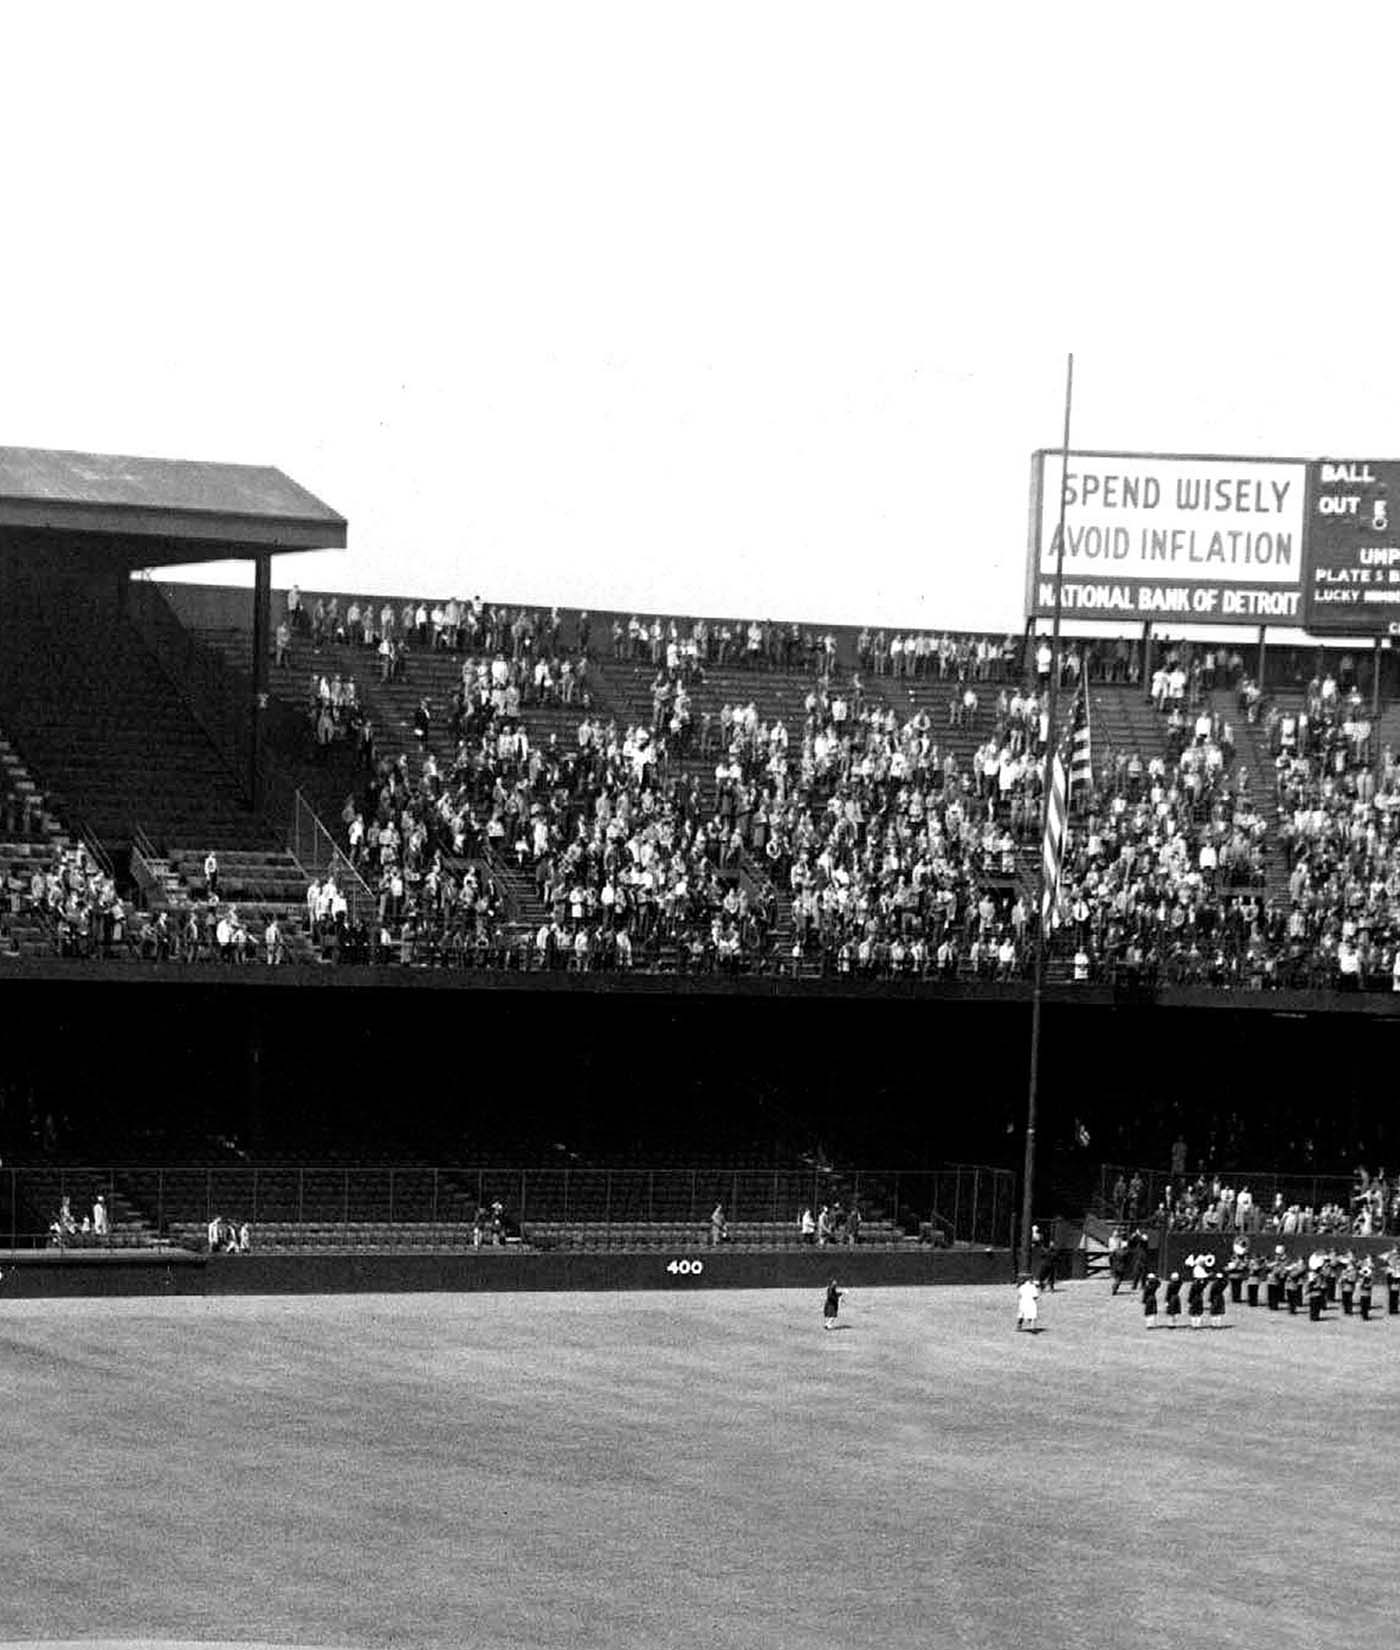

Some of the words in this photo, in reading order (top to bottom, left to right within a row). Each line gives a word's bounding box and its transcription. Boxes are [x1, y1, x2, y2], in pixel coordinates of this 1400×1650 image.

[1321, 464, 1375, 482] BALL
[1063, 474, 1161, 509] SPEND
[1176, 478, 1291, 513] WISELY
[1319, 496, 1361, 514] OUT
[1048, 523, 1130, 560] AVOID
[1141, 528, 1293, 565] INFLATION
[1315, 568, 1371, 583] PLATE
[1039, 583, 1135, 609] NATIONAL
[1138, 587, 1190, 611] BANK
[1193, 588, 1218, 612] OF
[1222, 590, 1301, 615] DETROIT
[1314, 588, 1360, 602] LUCKY
[666, 1260, 703, 1274] 400
